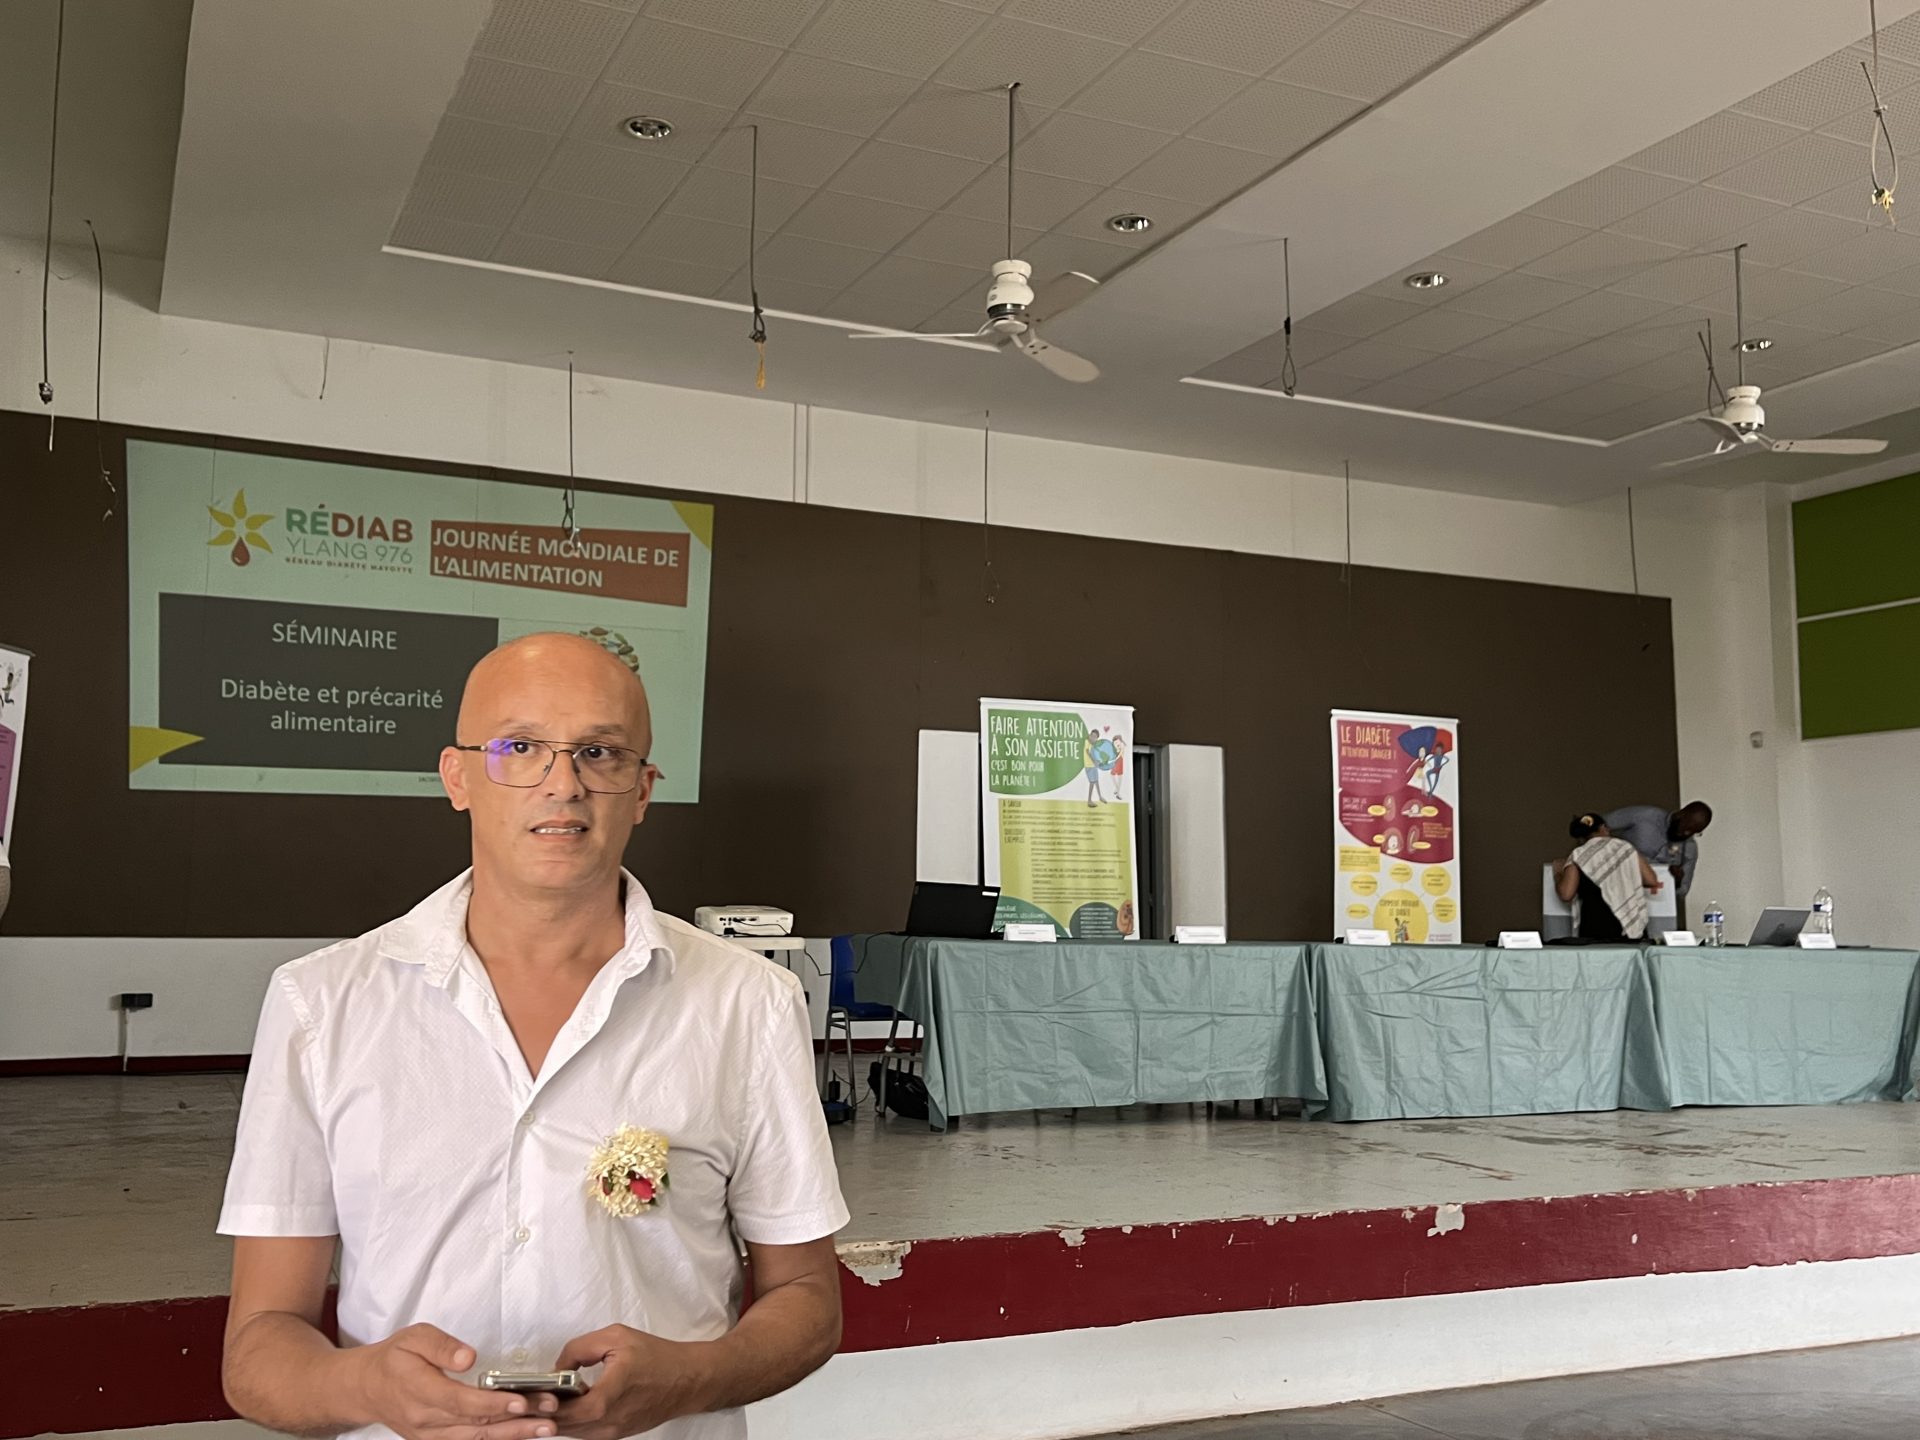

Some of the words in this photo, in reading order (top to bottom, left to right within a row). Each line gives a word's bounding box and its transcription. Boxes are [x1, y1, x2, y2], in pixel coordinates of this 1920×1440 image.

[286, 503, 413, 543] RÉDIAB
[286, 536, 368, 561] YLANG
[375, 544, 413, 564] 976
[433, 528, 531, 554] JOURNÉE
[538, 538, 648, 565] MONDIALE
[654, 549, 680, 568] DE
[433, 556, 603, 587] L’ALIMENTATION
[272, 619, 398, 650] SÉMINAIRE
[221, 678, 310, 702] Diabète
[317, 686, 340, 704] et
[347, 686, 443, 709] précarité
[271, 710, 397, 735] alimentaire
[990, 715, 1020, 736] FAIRE
[1026, 716, 1084, 738] ATTENTION
[1340, 725, 1351, 744] LE
[991, 733, 999, 756] À
[1005, 737, 1028, 757] SON
[1034, 738, 1080, 760] ASSIETTE
[1011, 760, 1026, 771] BON
[991, 774, 1000, 786] LA
